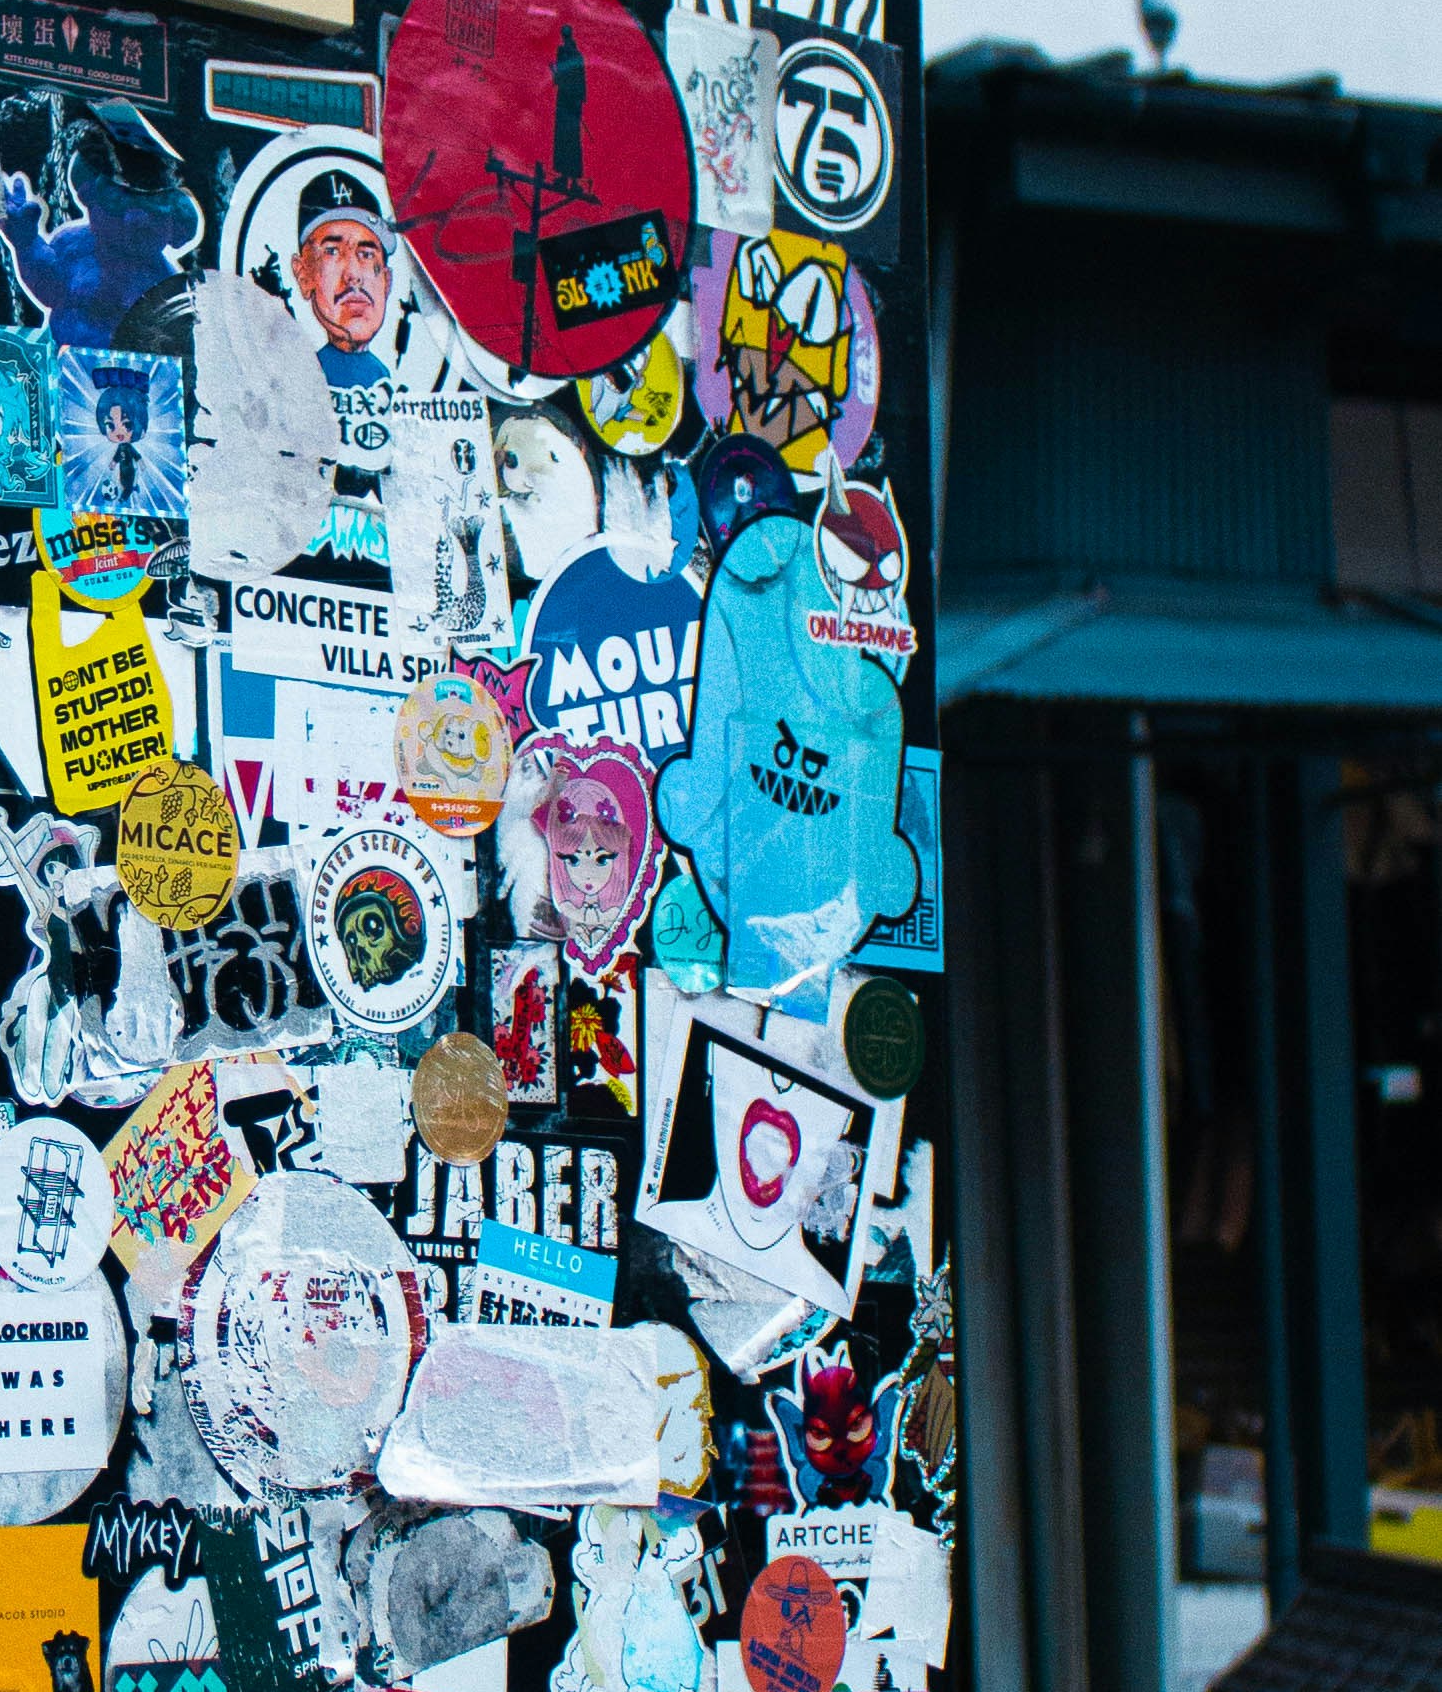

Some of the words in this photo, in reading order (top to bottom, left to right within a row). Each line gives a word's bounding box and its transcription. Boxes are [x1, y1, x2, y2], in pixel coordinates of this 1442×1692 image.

[233, 584, 389, 639] CONCRETE
[113, 643, 149, 674] BE
[321, 644, 394, 681] VILLA
[54, 670, 155, 726] STUPID!
[59, 702, 161, 755] MOTHER
[314, 843, 356, 925] SCOOTER
[360, 832, 412, 860] SCENE
[513, 1236, 583, 1274] HELLO
[1, 1368, 65, 1389] WAS
[775, 1524, 878, 1549] ARTCHE
[29, 1607, 66, 1621] STUDIO
